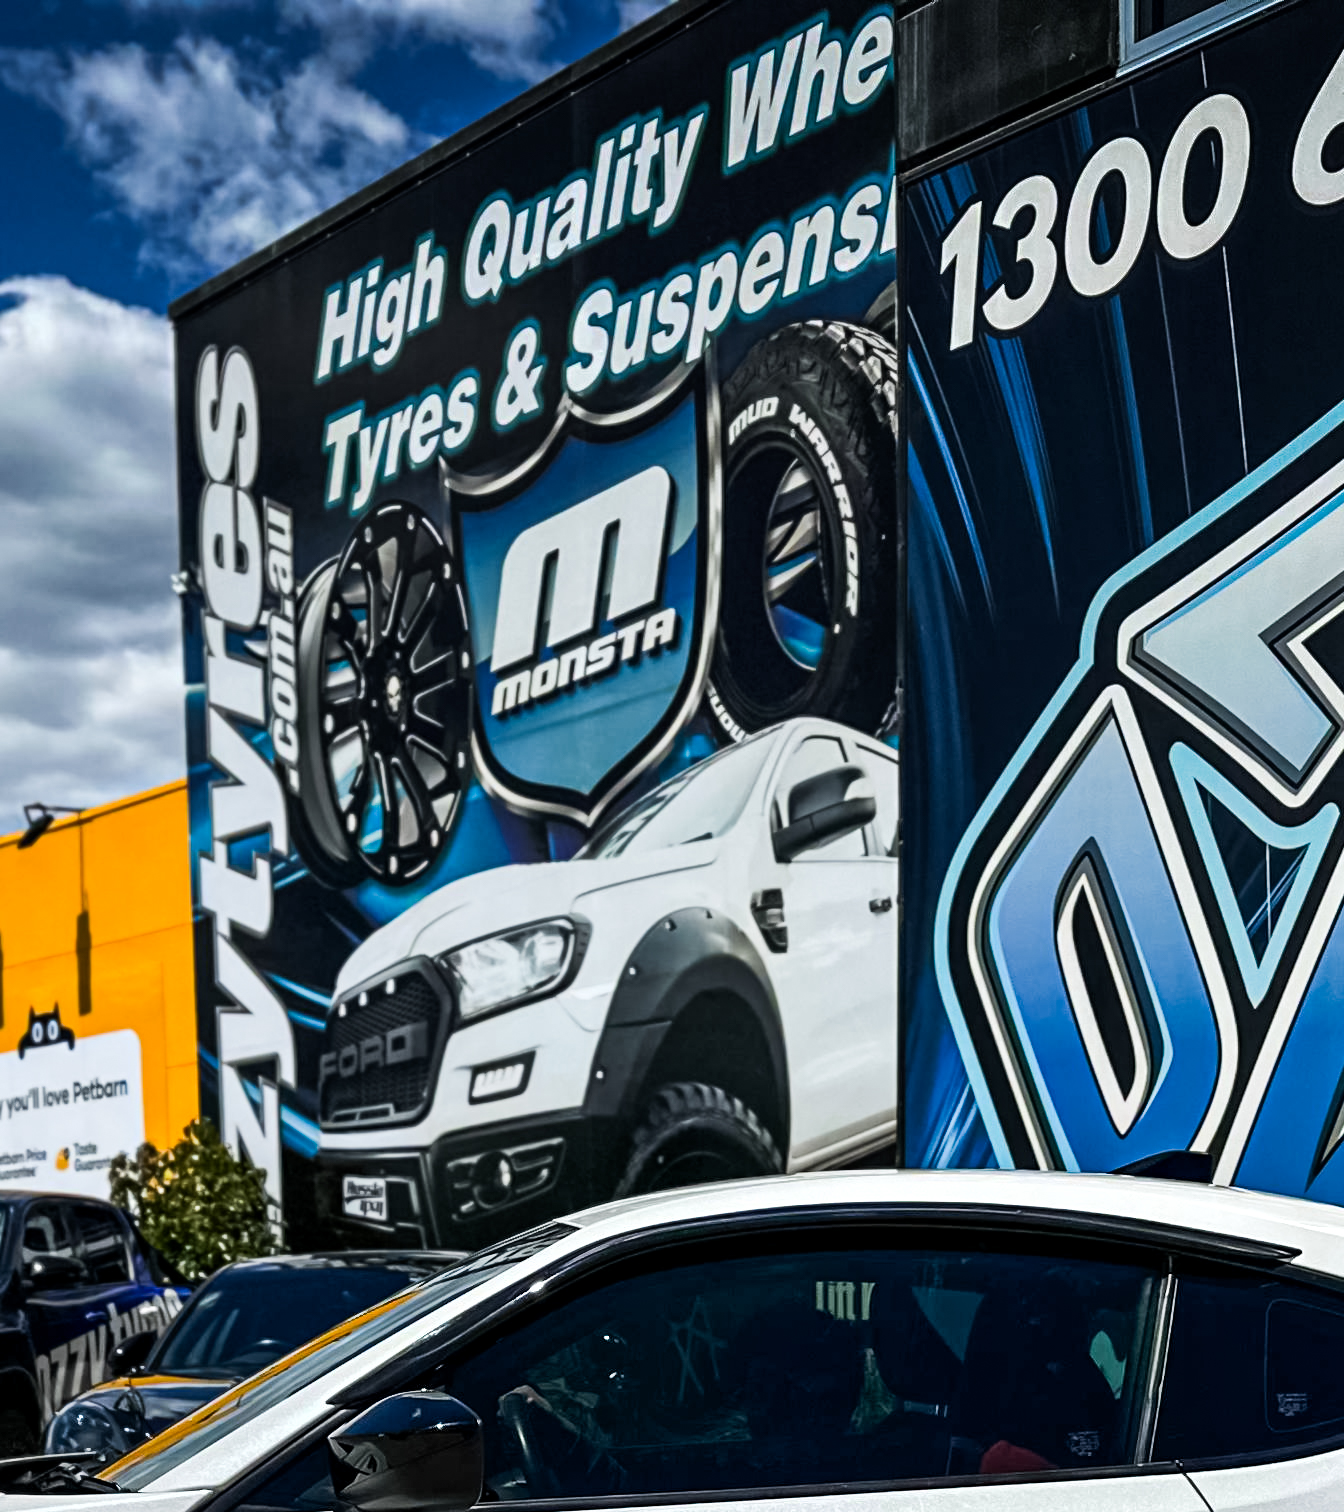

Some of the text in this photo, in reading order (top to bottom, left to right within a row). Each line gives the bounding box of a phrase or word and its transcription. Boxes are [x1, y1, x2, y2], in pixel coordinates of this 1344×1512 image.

[315, 238, 446, 381] High
[464, 112, 705, 297] Quality
[939, 92, 1252, 352] 1300
[325, 372, 478, 509] Tyres
[496, 327, 548, 428] &
[728, 396, 859, 617] MUD WARRIOR
[490, 606, 677, 717] MONSTA
[7, 1086, 40, 1119] you'll
[42, 1085, 69, 1108] love
[73, 1077, 129, 1103] Petbarn
[320, 1021, 422, 1082] FORD
